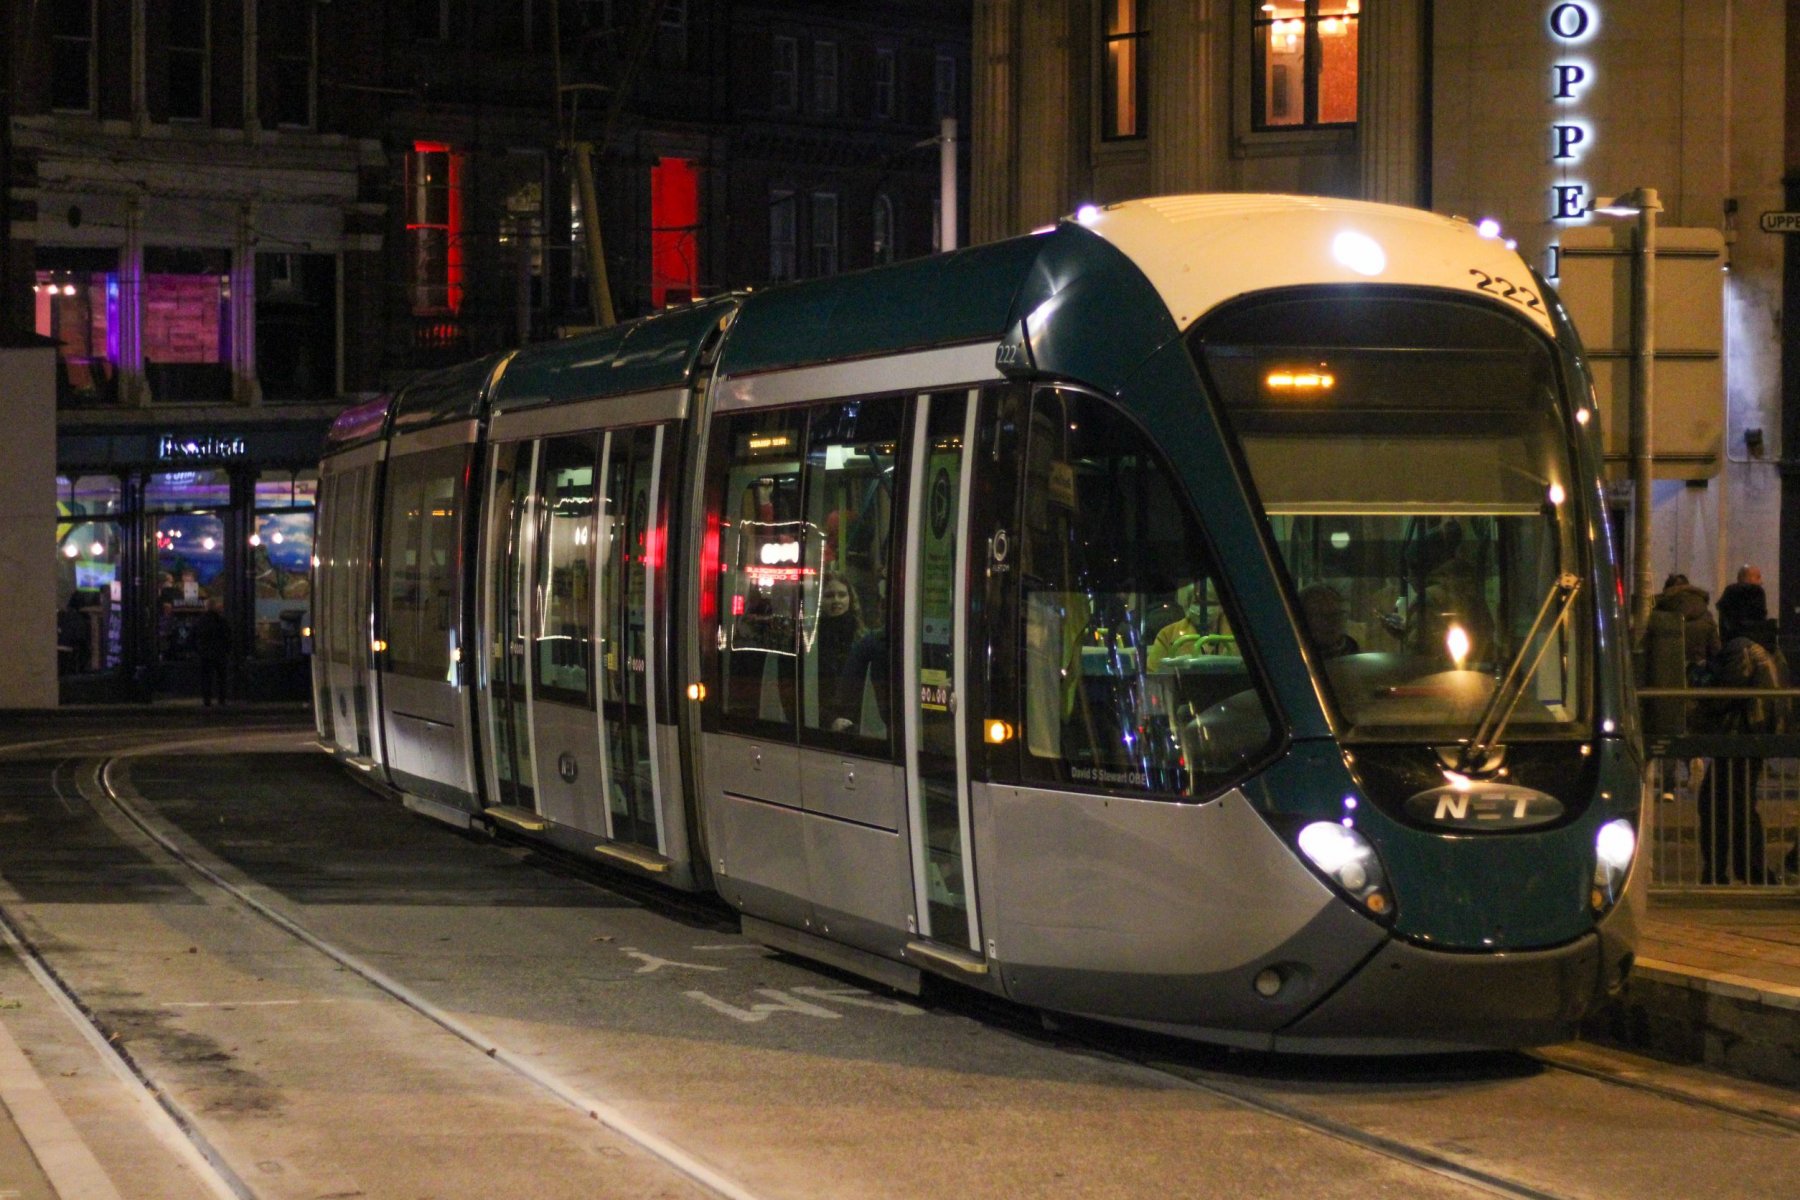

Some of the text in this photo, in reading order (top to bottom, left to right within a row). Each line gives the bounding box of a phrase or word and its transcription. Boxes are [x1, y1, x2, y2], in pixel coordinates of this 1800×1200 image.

[1469, 268, 1546, 316] 222
[997, 344, 1017, 364] 222
[1071, 766, 1146, 785] David S Stewart OBE
[1434, 793, 1537, 820] NET
